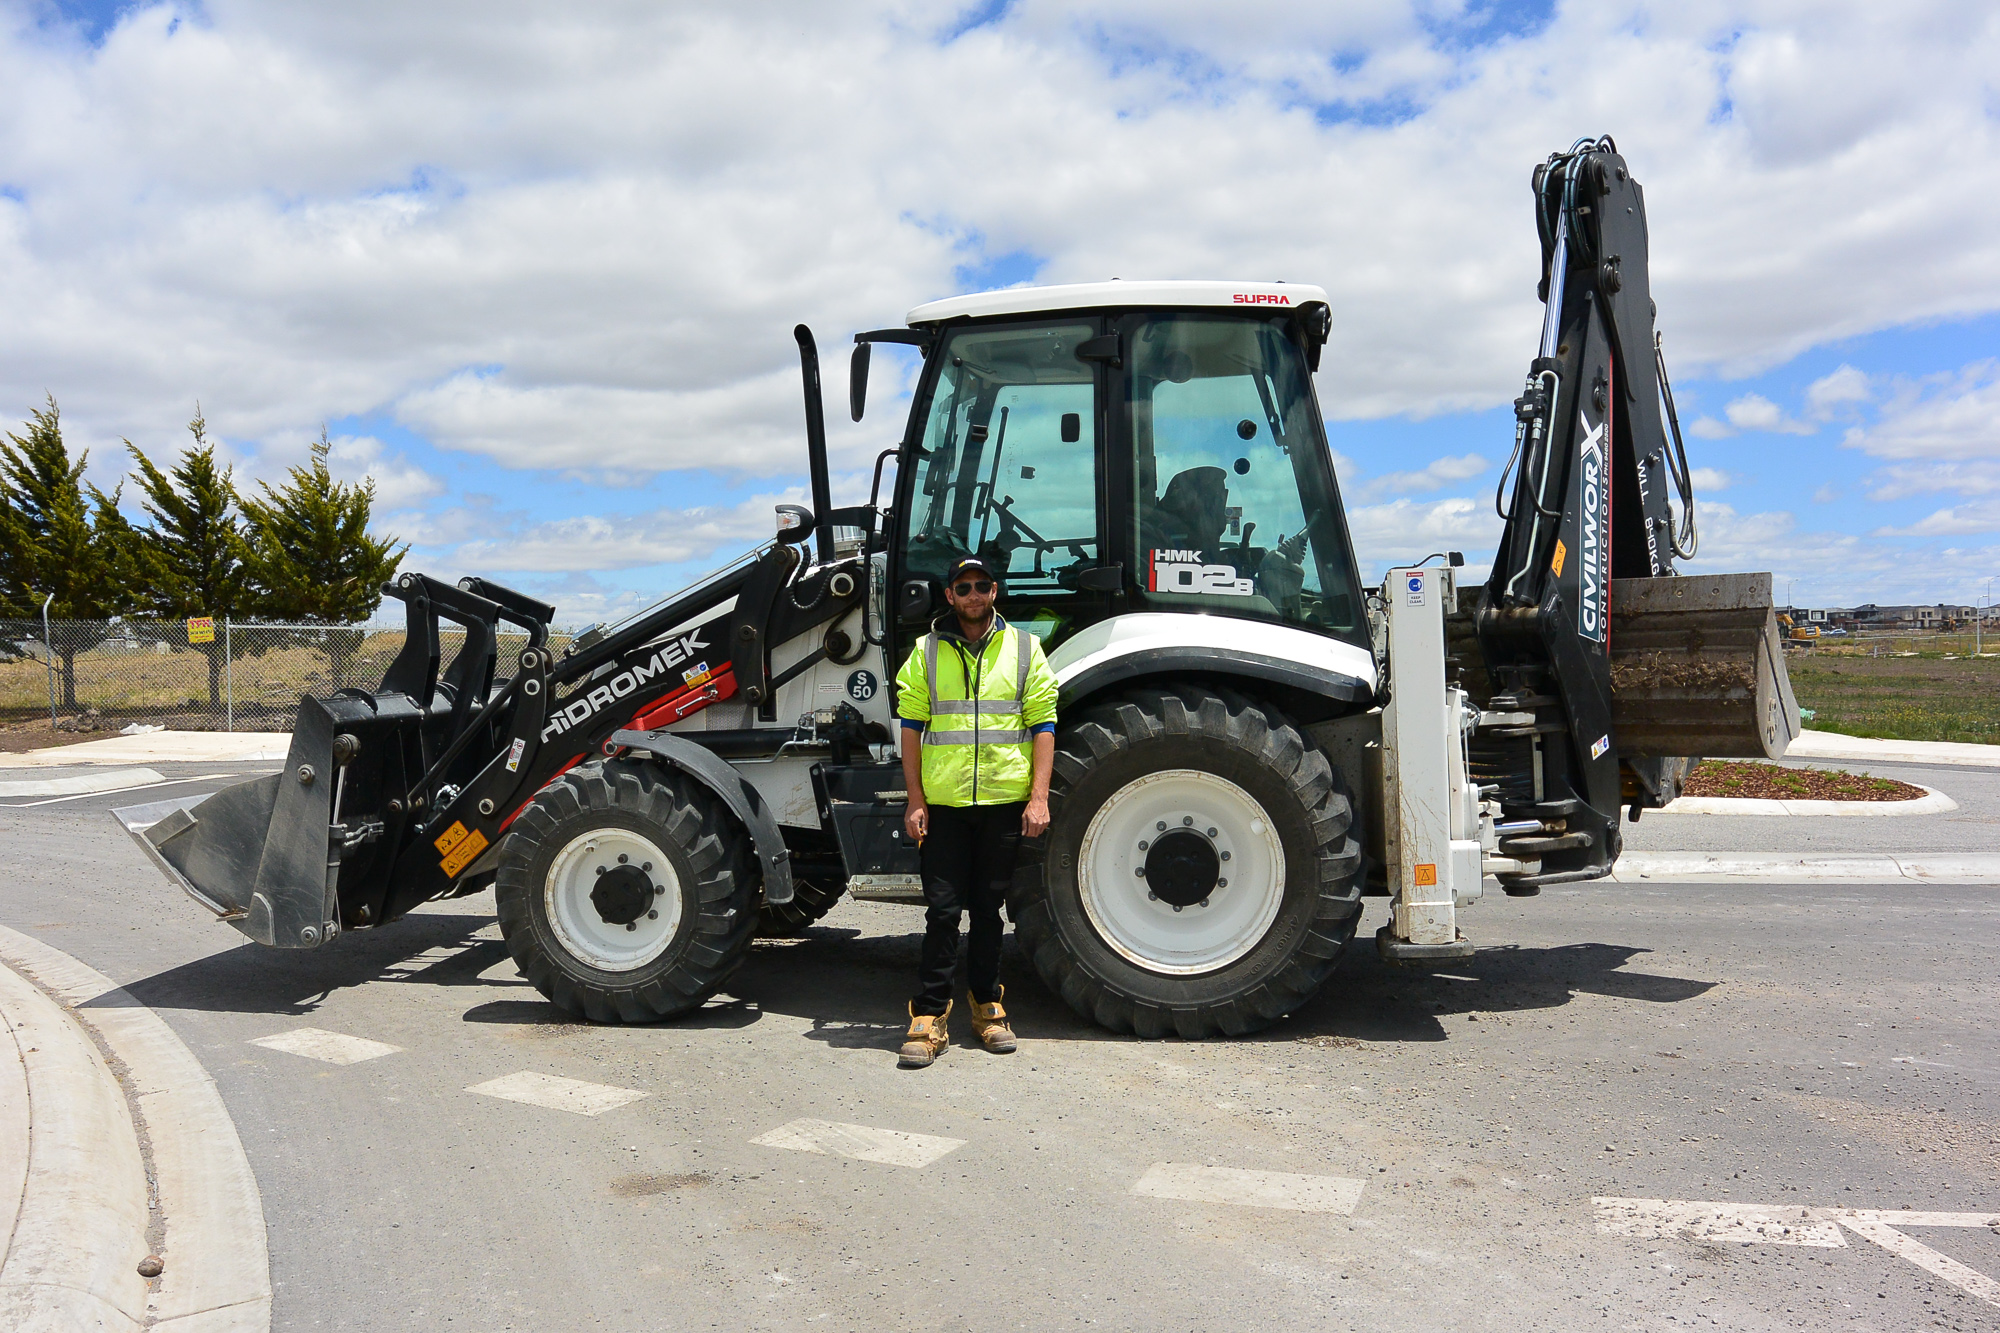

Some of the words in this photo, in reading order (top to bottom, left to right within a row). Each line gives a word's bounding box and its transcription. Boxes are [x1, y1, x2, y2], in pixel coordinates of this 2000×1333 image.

[1233, 294, 1290, 304] SUPRA
[1581, 409, 1603, 632] CIVILWORX
[1155, 549, 1203, 563] HMK
[1600, 476, 1609, 643] CONSTRUCTIONS
[1155, 562, 1254, 596] 102B
[857, 672, 868, 686] S
[853, 685, 872, 699] 50
